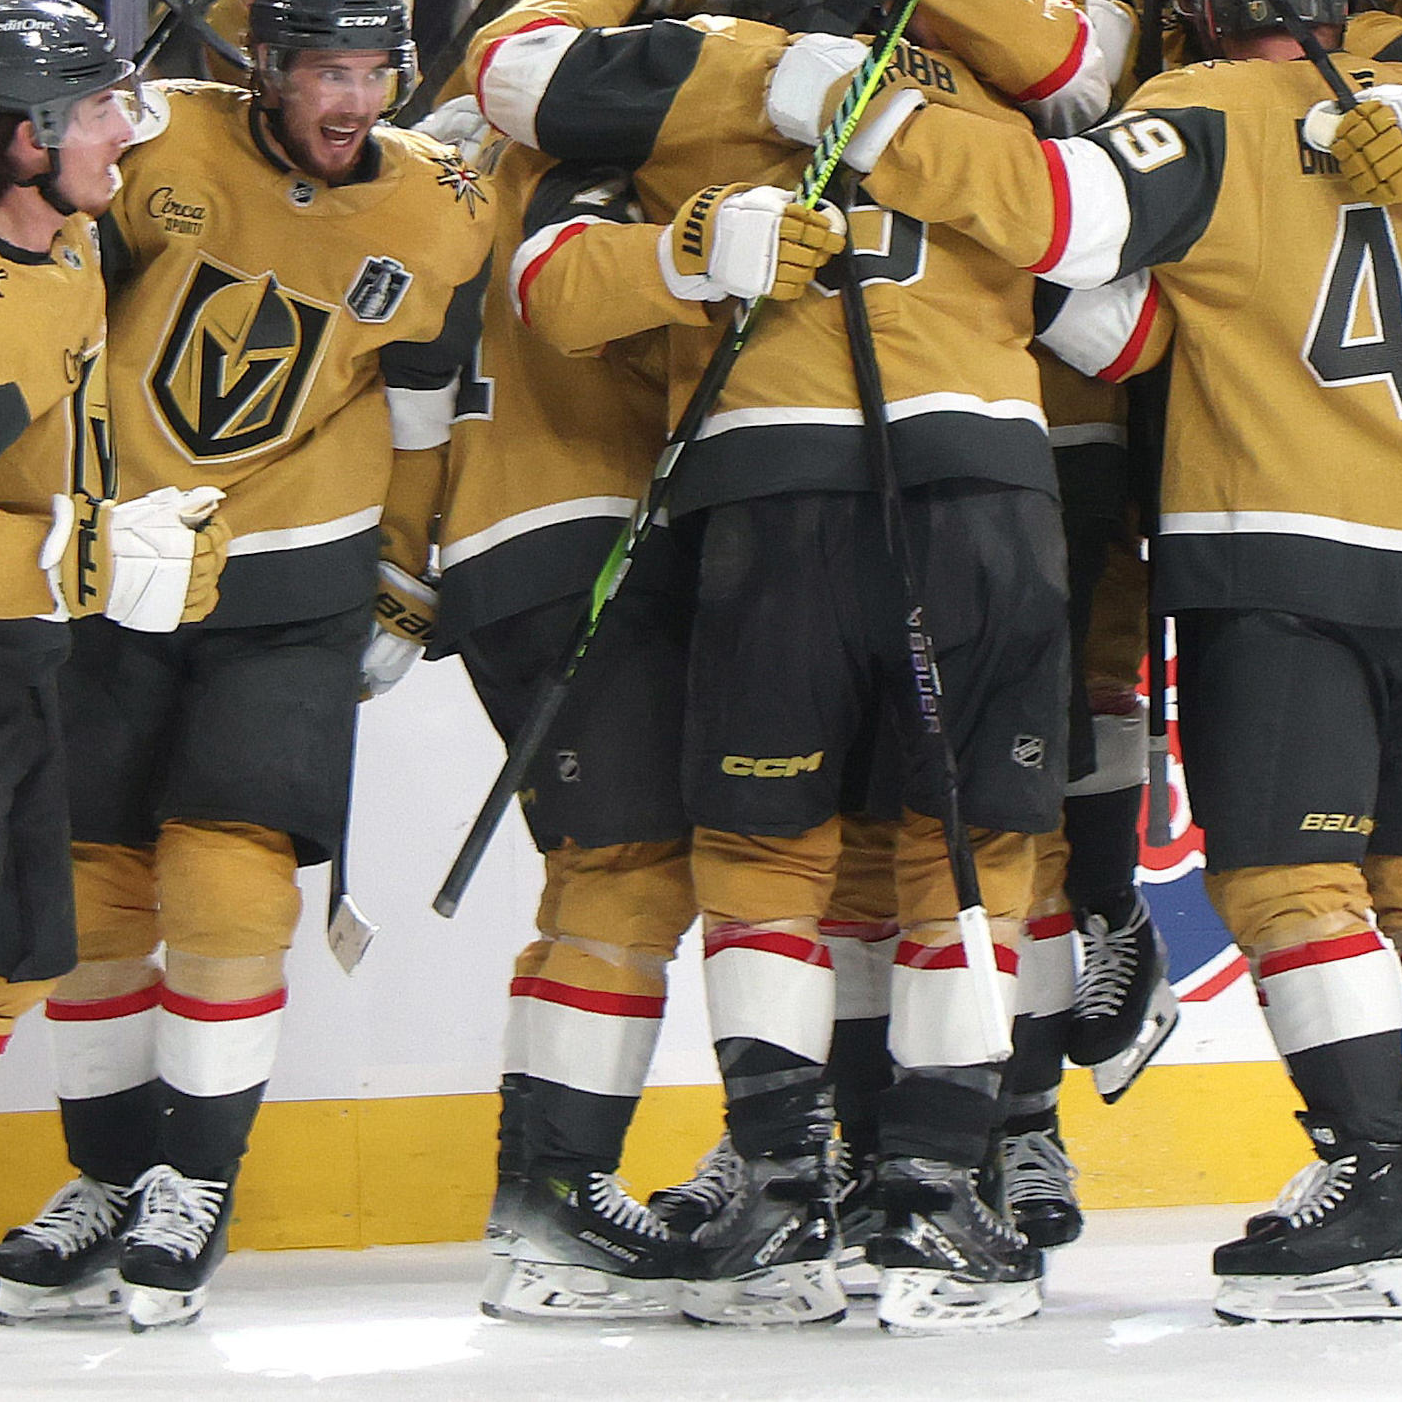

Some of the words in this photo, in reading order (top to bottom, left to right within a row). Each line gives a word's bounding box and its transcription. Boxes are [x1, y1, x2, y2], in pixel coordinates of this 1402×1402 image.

[336, 15, 388, 27] CCM
[146, 186, 207, 219] Circa
[721, 751, 825, 778] CCM
